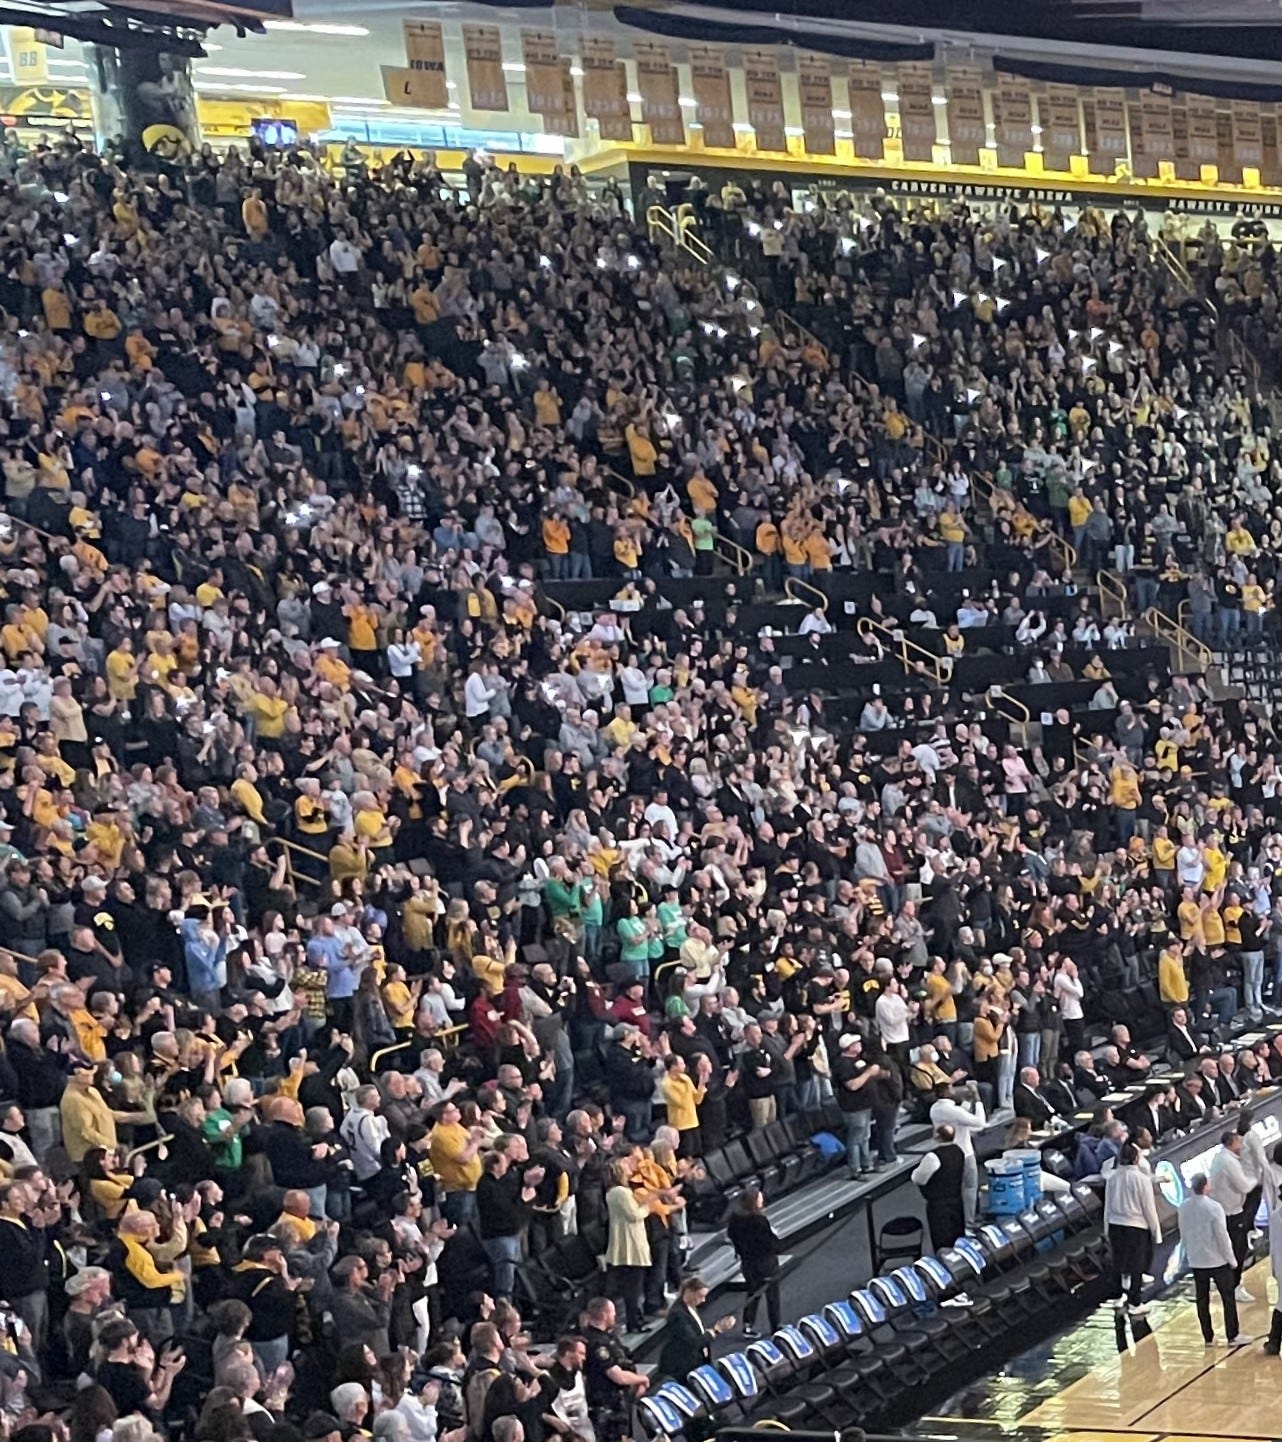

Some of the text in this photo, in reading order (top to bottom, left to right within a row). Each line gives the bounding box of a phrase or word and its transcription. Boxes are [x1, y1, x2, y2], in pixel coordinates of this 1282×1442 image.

[891, 180, 1073, 202] CARVER-HAWKEYE ARENA
[1168, 199, 1231, 213] HAWKEYE
